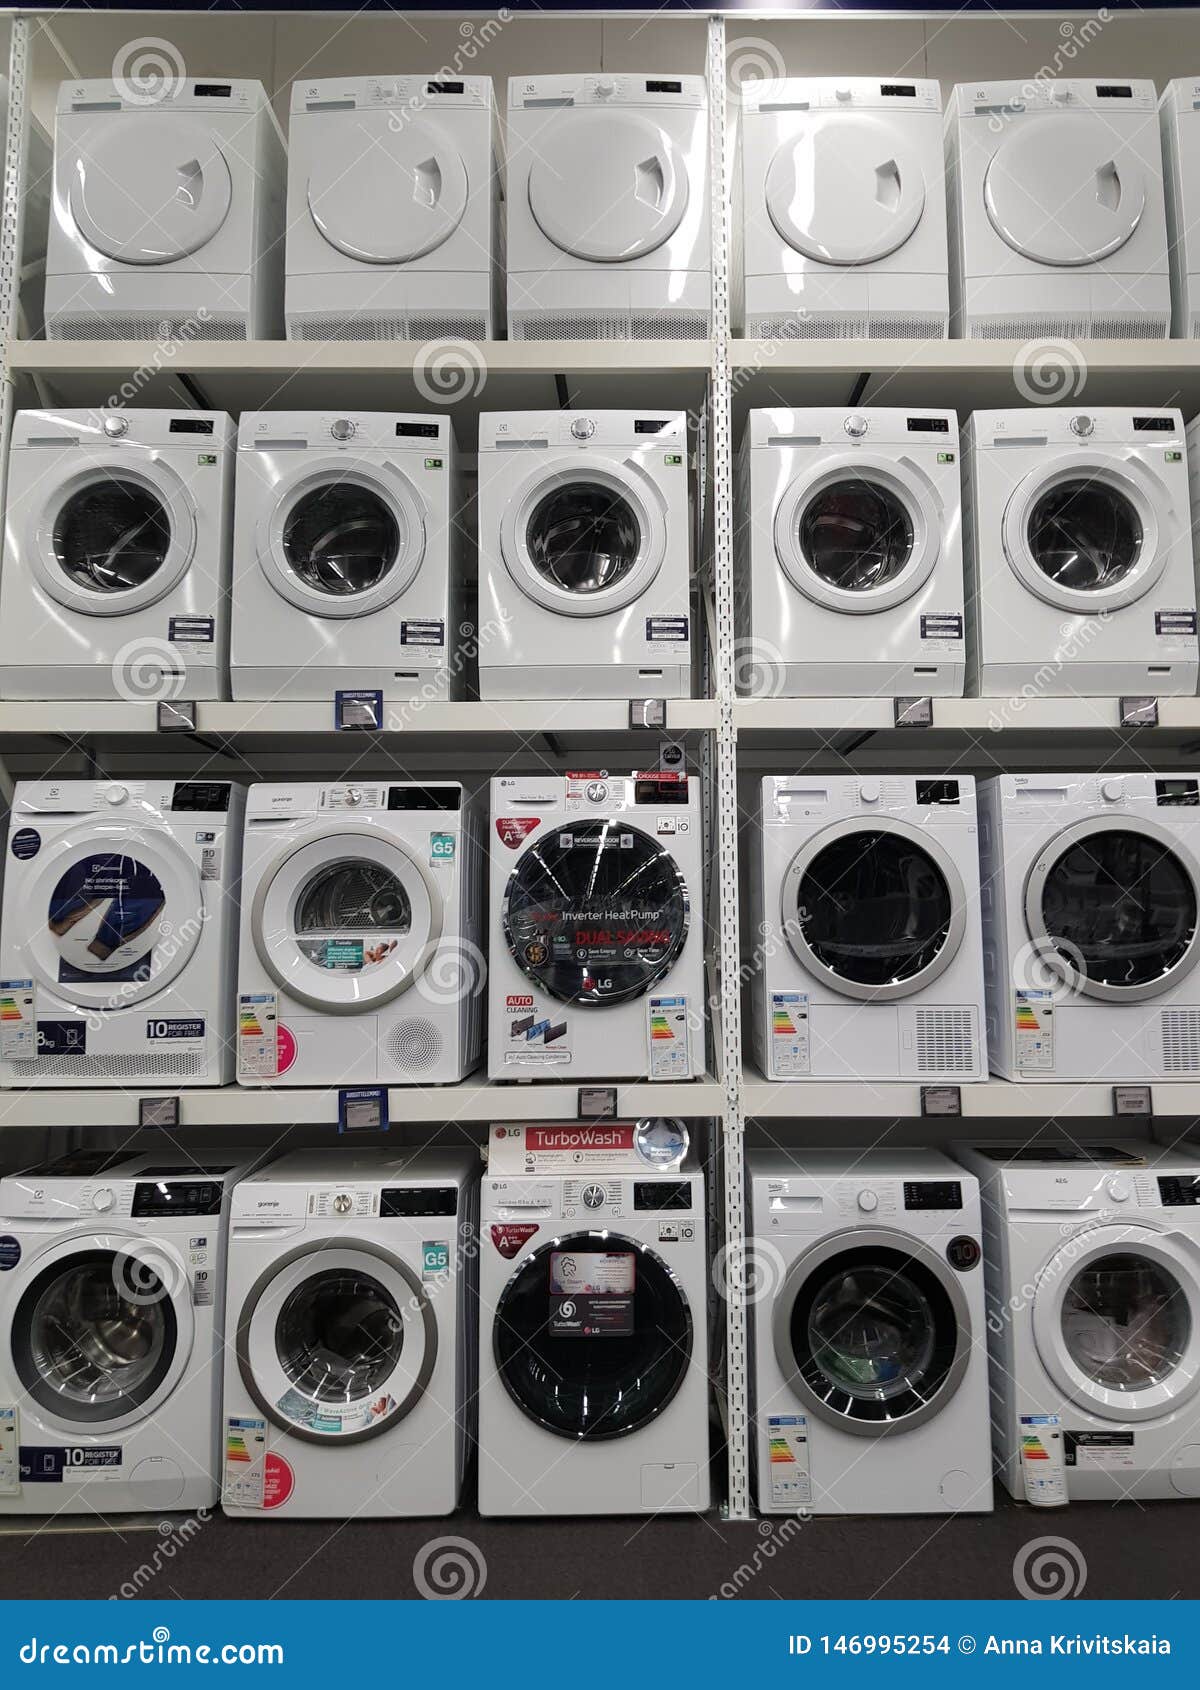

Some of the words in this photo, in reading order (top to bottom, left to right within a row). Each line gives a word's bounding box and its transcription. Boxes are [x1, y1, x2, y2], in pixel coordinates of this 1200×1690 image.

[433, 841, 453, 854] G5
[562, 911, 602, 921] Inverter
[598, 979, 612, 988] LG
[508, 997, 532, 1005] AUTO
[149, 1021, 168, 1037] 10
[508, 1129, 520, 1137] LG
[426, 1252, 447, 1266] G5
[197, 1272, 208, 1280] 10
[64, 1448, 85, 1466] 10
